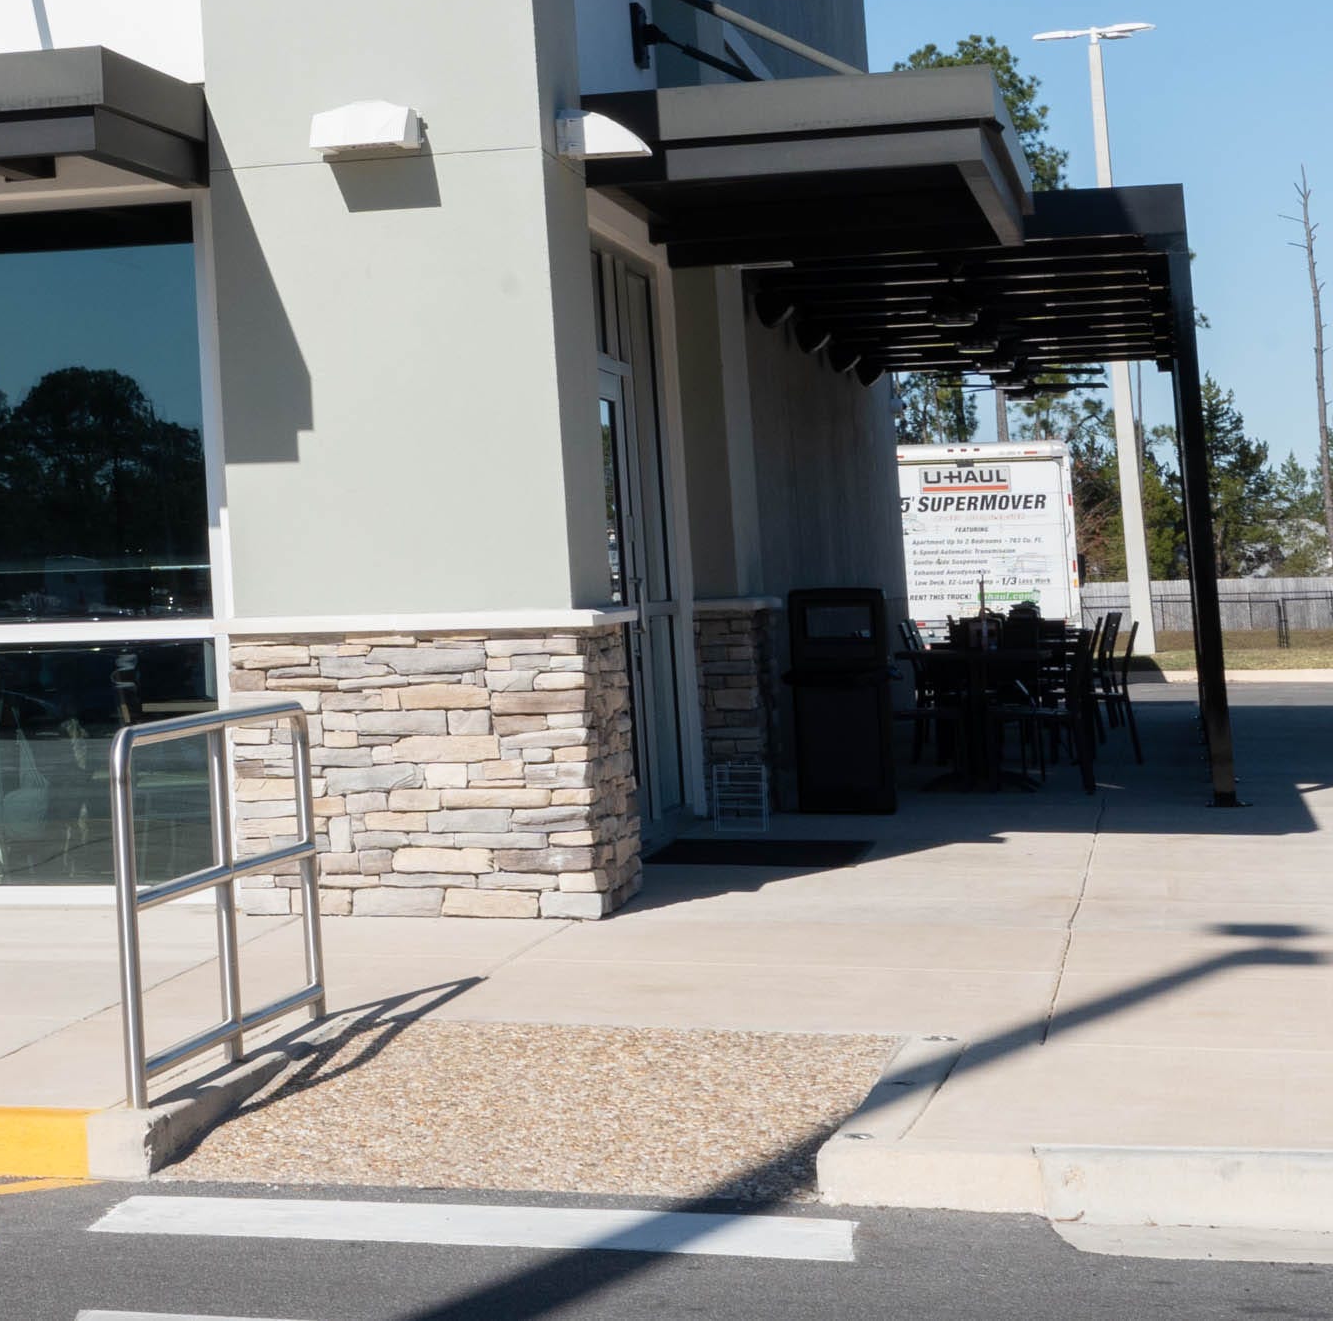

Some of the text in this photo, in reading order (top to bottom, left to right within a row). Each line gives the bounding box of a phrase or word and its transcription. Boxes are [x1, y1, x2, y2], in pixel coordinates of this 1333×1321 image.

[923, 469, 1007, 484] U-HAUL
[917, 494, 1046, 513] SUPERMOVER
[1001, 576, 1017, 586] 1/3
